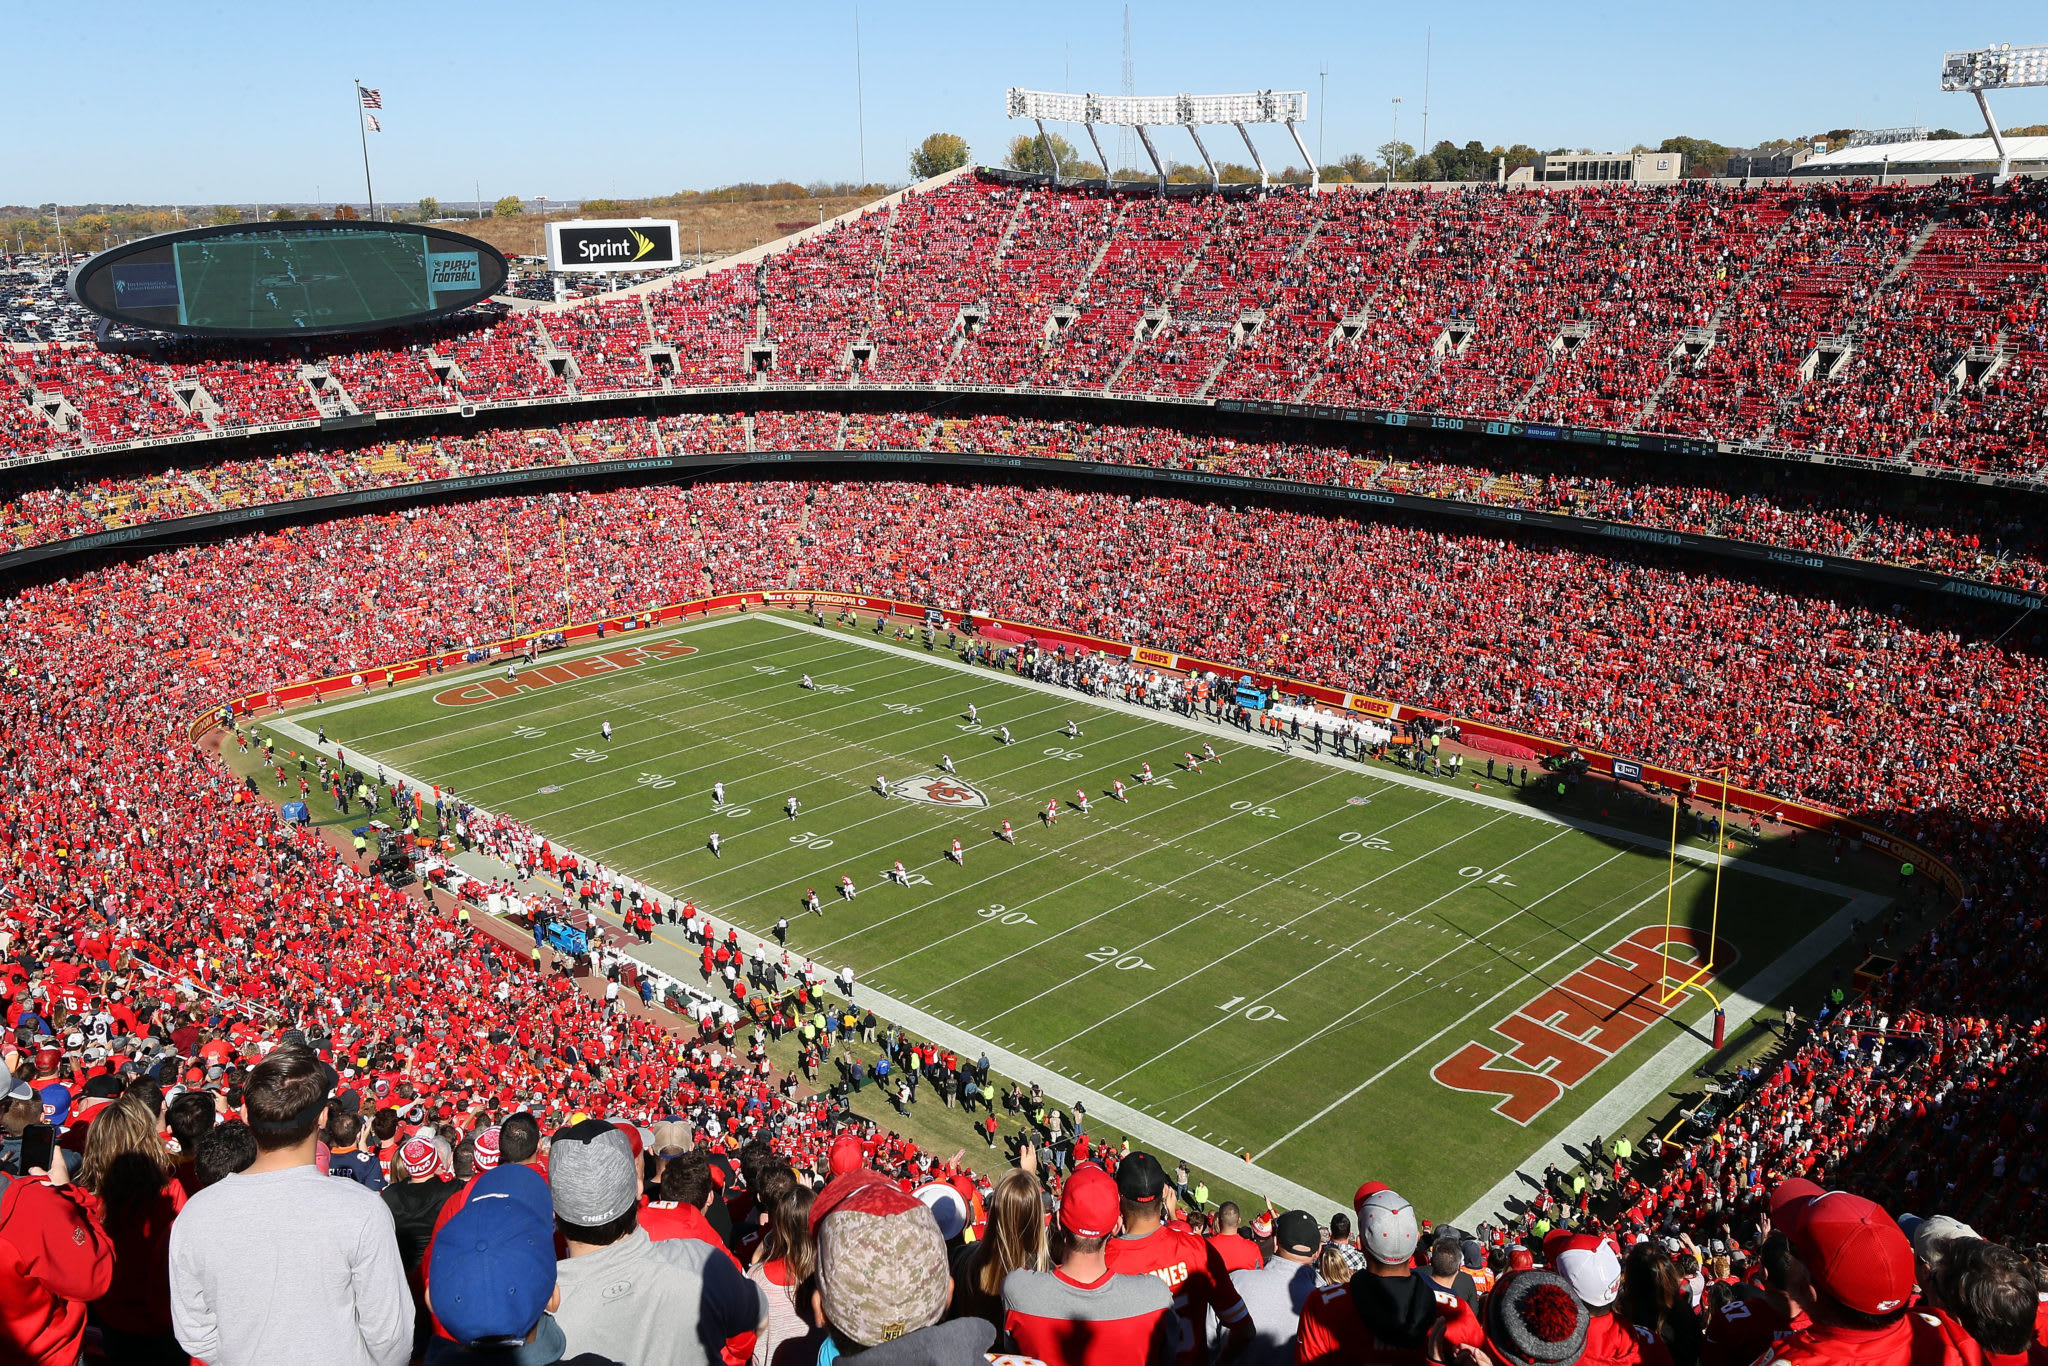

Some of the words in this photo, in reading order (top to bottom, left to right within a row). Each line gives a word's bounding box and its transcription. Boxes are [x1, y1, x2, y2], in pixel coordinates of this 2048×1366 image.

[578, 239, 631, 261] Sprint
[442, 260, 470, 272] PLAY
[432, 269, 476, 283] FOOTBALL
[608, 392, 637, 400] PODOLAK
[665, 388, 687, 396] LYNCH
[478, 402, 496, 410] HANK
[535, 397, 558, 405] JERREL
[395, 410, 420, 418] EMMITT
[421, 407, 448, 416] THOMAS
[1391, 414, 1398, 424] 0
[268, 423, 290, 432] WILLIE
[291, 421, 315, 429] LANIER
[1431, 417, 1464, 430] 15:00
[1497, 423, 1505, 434] 0
[151, 438, 168, 446] OTIS
[170, 434, 196, 444] TAYLOR
[214, 430, 225, 438] ED
[225, 428, 249, 436] BUDDE
[71, 449, 92, 457] BUCK
[92, 443, 132, 454] BUCHANAN
[859, 452, 922, 462] ARROWHEAD
[1741, 447, 1783, 459] CHRISTIAN
[1784, 452, 1813, 462] OKOYE
[9, 457, 33, 467] BOBBY
[34, 455, 52, 463] BELL
[1836, 458, 1874, 470] DERRICK
[1875, 463, 1913, 474] THOMAS
[355, 484, 424, 502] ARROWHEAD
[440, 480, 469, 490] THE
[470, 473, 530, 487] LOUDEST
[532, 466, 586, 480] STADIUM
[587, 466, 599, 474] IN
[600, 463, 625, 472] THE
[627, 459, 673, 470] WORLD
[1094, 465, 1154, 478] ARROWHEAD
[1170, 473, 1195, 482] THE
[1197, 476, 1253, 488] LOUDEST
[1254, 481, 1308, 494] STADIUM
[1308, 487, 1320, 496] IN
[1322, 489, 1346, 499] THE
[1348, 492, 1395, 504] WORLD
[1936, 471, 1962, 480] JOHN
[1963, 474, 1980, 483] ALT
[64, 528, 142, 551] ARROWHEAD
[1600, 525, 1682, 546] ARROWHEAD
[783, 593, 813, 601] CHIEFS
[814, 594, 856, 605] KINGDOM
[1940, 582, 2042, 610] ARROWHEAD
[1138, 650, 1169, 665] CHIEFS
[433, 638, 699, 706] CHIEFS
[819, 683, 856, 695] 20
[887, 703, 924, 715] 30
[1353, 698, 1390, 715] CHIEFS
[512, 726, 547, 739] 10
[570, 749, 609, 763] 20
[1043, 747, 1084, 762] 50
[637, 774, 677, 790] 30
[921, 781, 974, 803] KC
[1230, 801, 1273, 818] 30
[788, 831, 834, 850] 50
[1338, 831, 1385, 851] 20
[1862, 831, 1880, 845] THIS
[1881, 839, 1890, 849] IS
[1458, 865, 1511, 887] 10
[977, 903, 1030, 926] 30
[1085, 945, 1145, 971] 20
[63, 996, 78, 1011] 16
[1215, 995, 1276, 1022] 10
[1430, 924, 1741, 1127] CHIEFS
[582, 1209, 615, 1223] CHIEFS
[1721, 1300, 1752, 1323] 87
